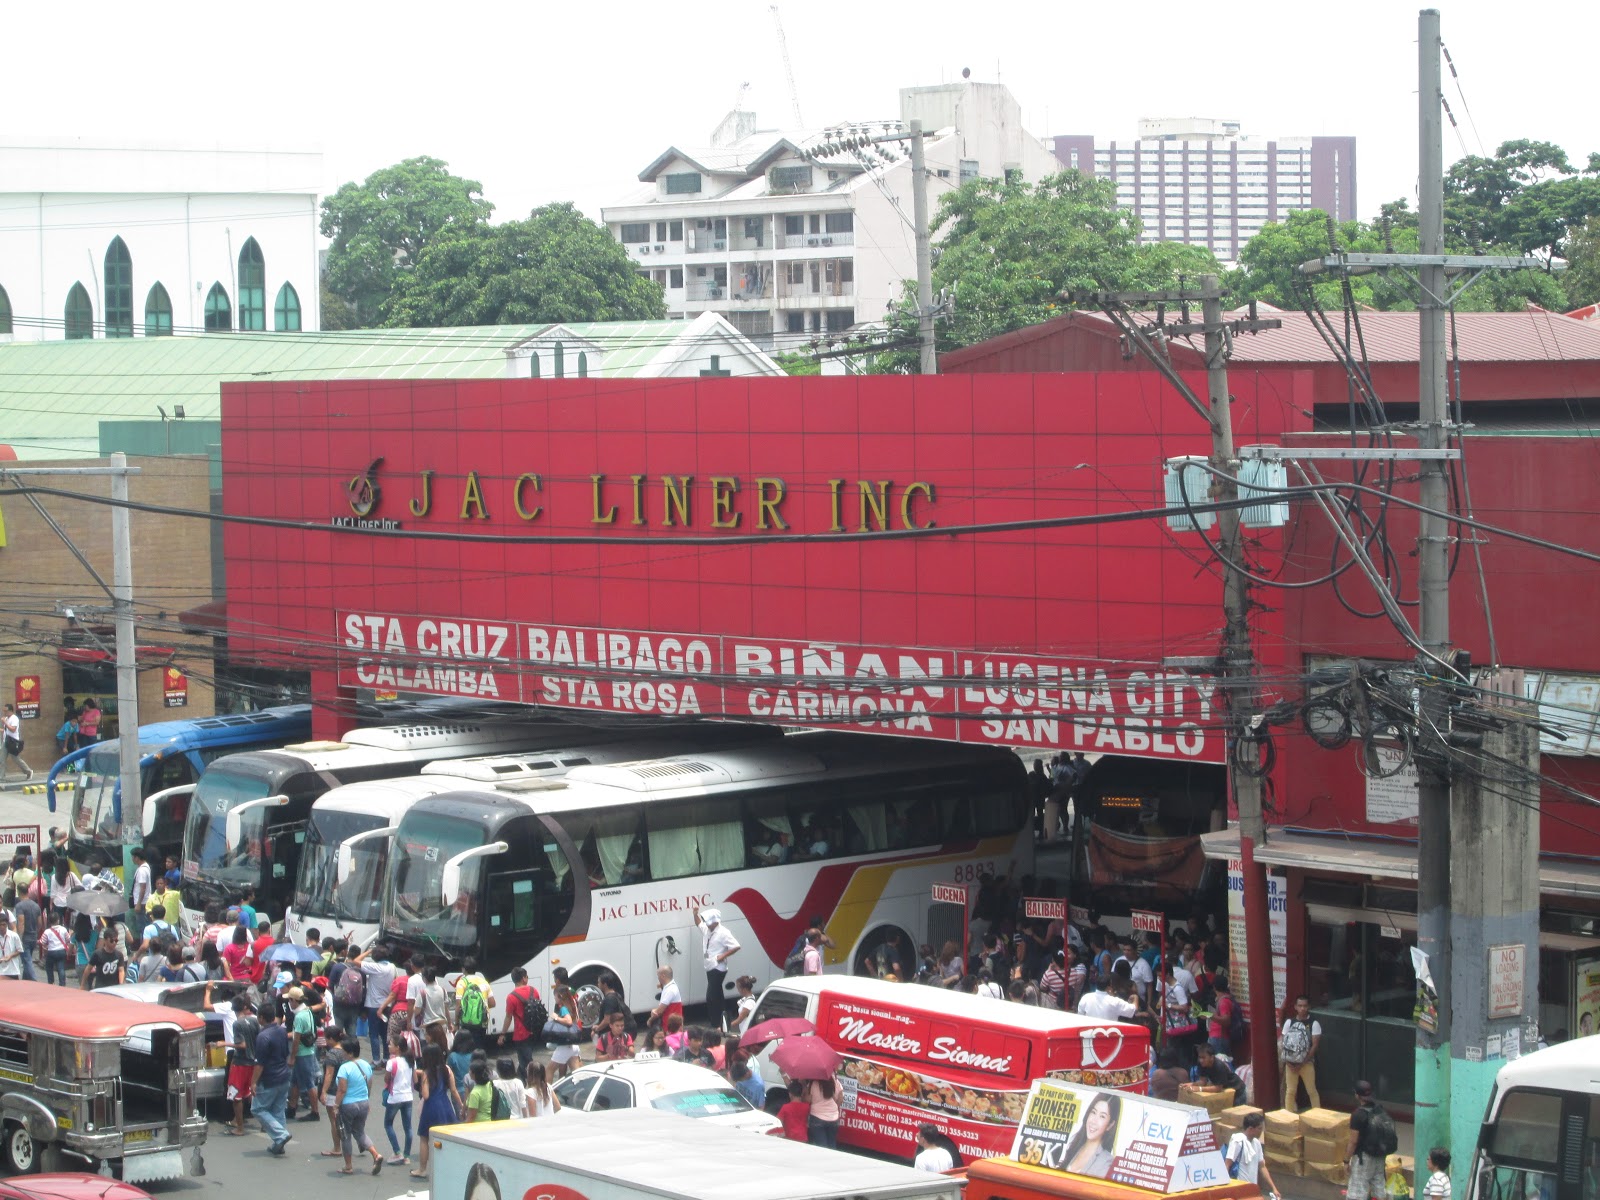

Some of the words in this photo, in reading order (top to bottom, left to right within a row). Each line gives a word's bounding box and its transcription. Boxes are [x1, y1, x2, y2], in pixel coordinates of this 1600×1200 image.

[409, 470, 543, 520] JAC
[591, 474, 790, 531] LINER
[828, 479, 937, 532] INC
[345, 614, 407, 653] STA
[416, 620, 510, 666] CRUZ
[528, 628, 712, 675] BALIBAGO
[356, 657, 500, 697] CALAMBA
[735, 642, 944, 698] BIÑAN
[542, 675, 603, 707] STA
[612, 680, 701, 715] ROSA
[964, 660, 1115, 713] LUCENA
[1126, 671, 1218, 721] CITY
[748, 687, 933, 732] CARMONA
[981, 706, 1060, 744] SAN
[1073, 717, 1205, 756] PABLO
[933, 886, 965, 903] LUCENA
[599, 905, 628, 922] JAC
[634, 897, 683, 917] LINER,
[686, 893, 715, 909] INC.
[1026, 901, 1065, 919] BALIBAGO
[1496, 962, 1519, 974] LOADING
[1501, 950, 1516, 962] NO
[1492, 981, 1521, 994] UNLOADING
[839, 1016, 921, 1055] Master
[928, 1037, 1012, 1073] Siomai
[1046, 1090, 1057, 1098] PART
[1058, 1092, 1064, 1100] OF
[1064, 1093, 1074, 1101] OUR
[867, 1099, 887, 1110] inquiry:
[888, 1104, 948, 1123] www.mastersiomai.com
[1031, 1097, 1077, 1119] PIONEER
[847, 1118, 877, 1134] LUZON,
[879, 1126, 913, 1142] VISAYAS
[858, 1107, 869, 1116] Tel.
[870, 1110, 885, 1119] Nos.:
[886, 1114, 900, 1125] (02)
[949, 1128, 979, 1141] 355-5323
[1027, 1114, 1051, 1129] SALES
[1052, 1118, 1074, 1133] TEAM
[1032, 1129, 1043, 1137] EARN
[1048, 1132, 1060, 1140] MUCH
[1148, 1122, 1173, 1141] EXL
[1187, 1126, 1199, 1134] APPLY
[1199, 1124, 1212, 1133] NOW!
[1019, 1138, 1068, 1169] 35K!
[1125, 1150, 1141, 1161] YOUR
[1141, 1154, 1167, 1167] CAREER!
[1127, 1161, 1137, 1170] TWO
[1194, 1168, 1216, 1182] EXL
